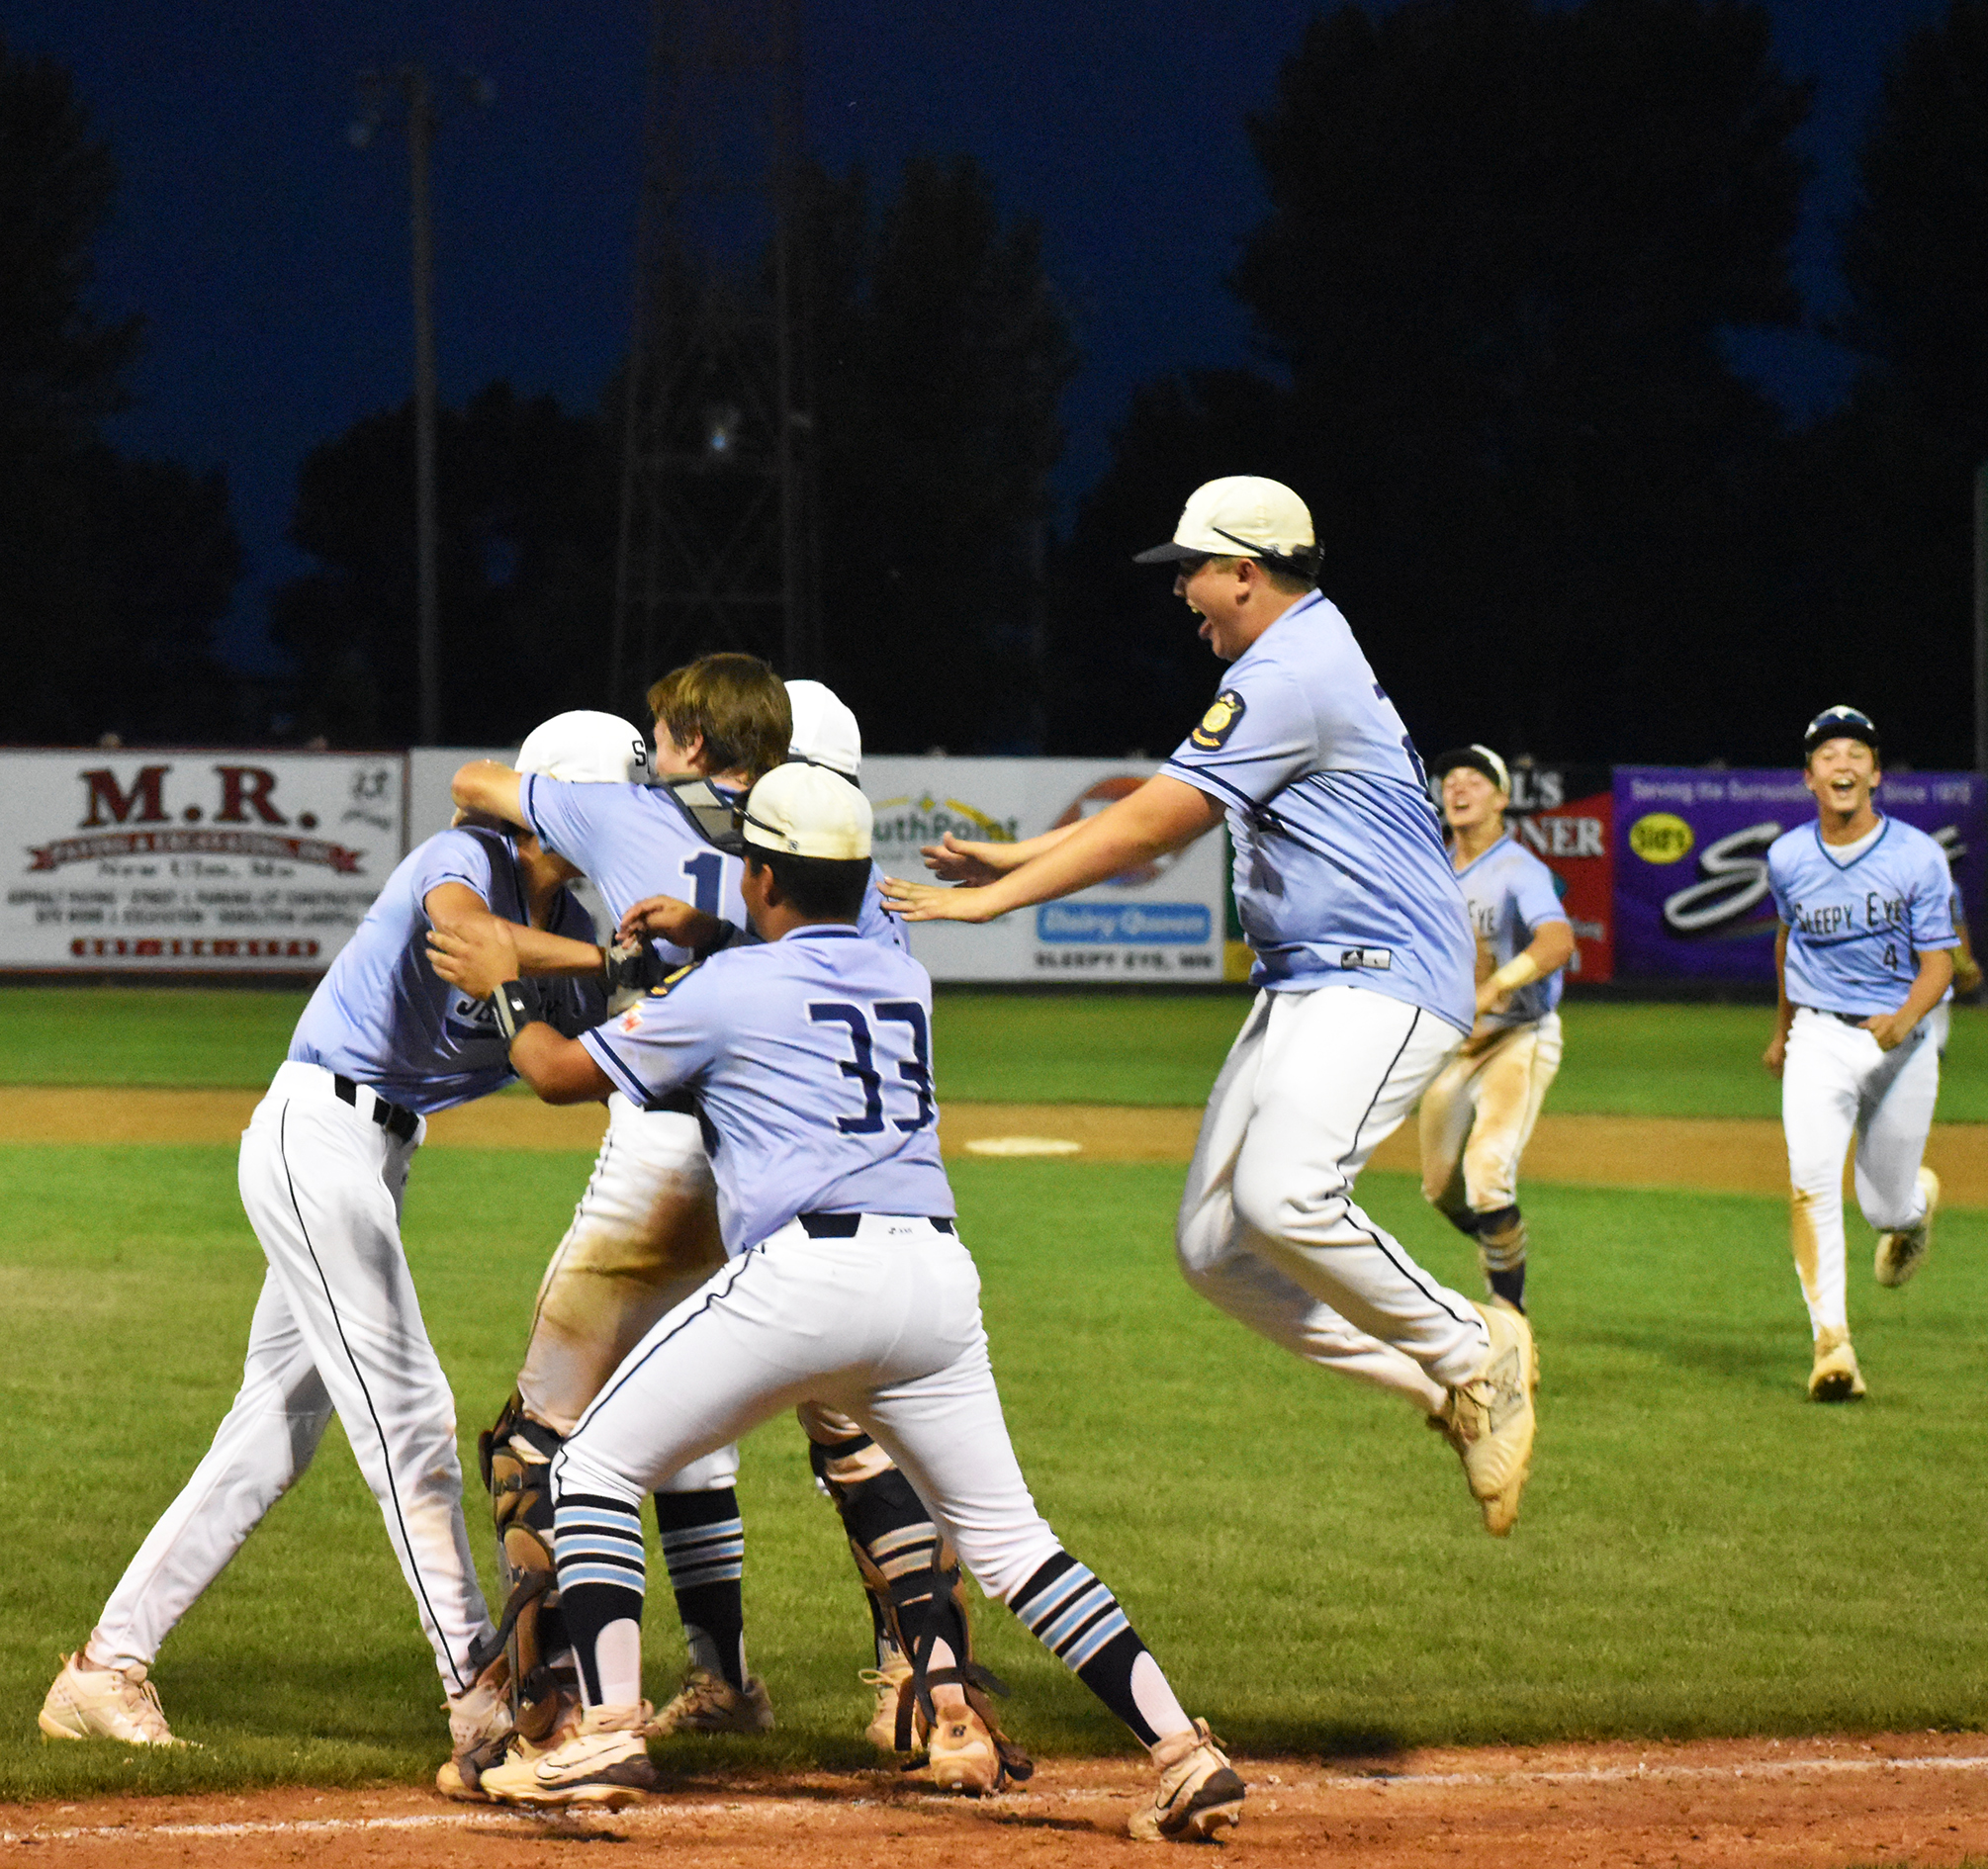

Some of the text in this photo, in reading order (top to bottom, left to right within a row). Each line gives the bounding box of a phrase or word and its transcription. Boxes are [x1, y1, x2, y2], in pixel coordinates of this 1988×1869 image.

[79, 764, 319, 830] M.R.
[873, 813, 1018, 843] uthPoint
[1035, 952, 1116, 968] SLEEPY
[1883, 942, 1898, 971] 4
[804, 999, 938, 1136] 33
